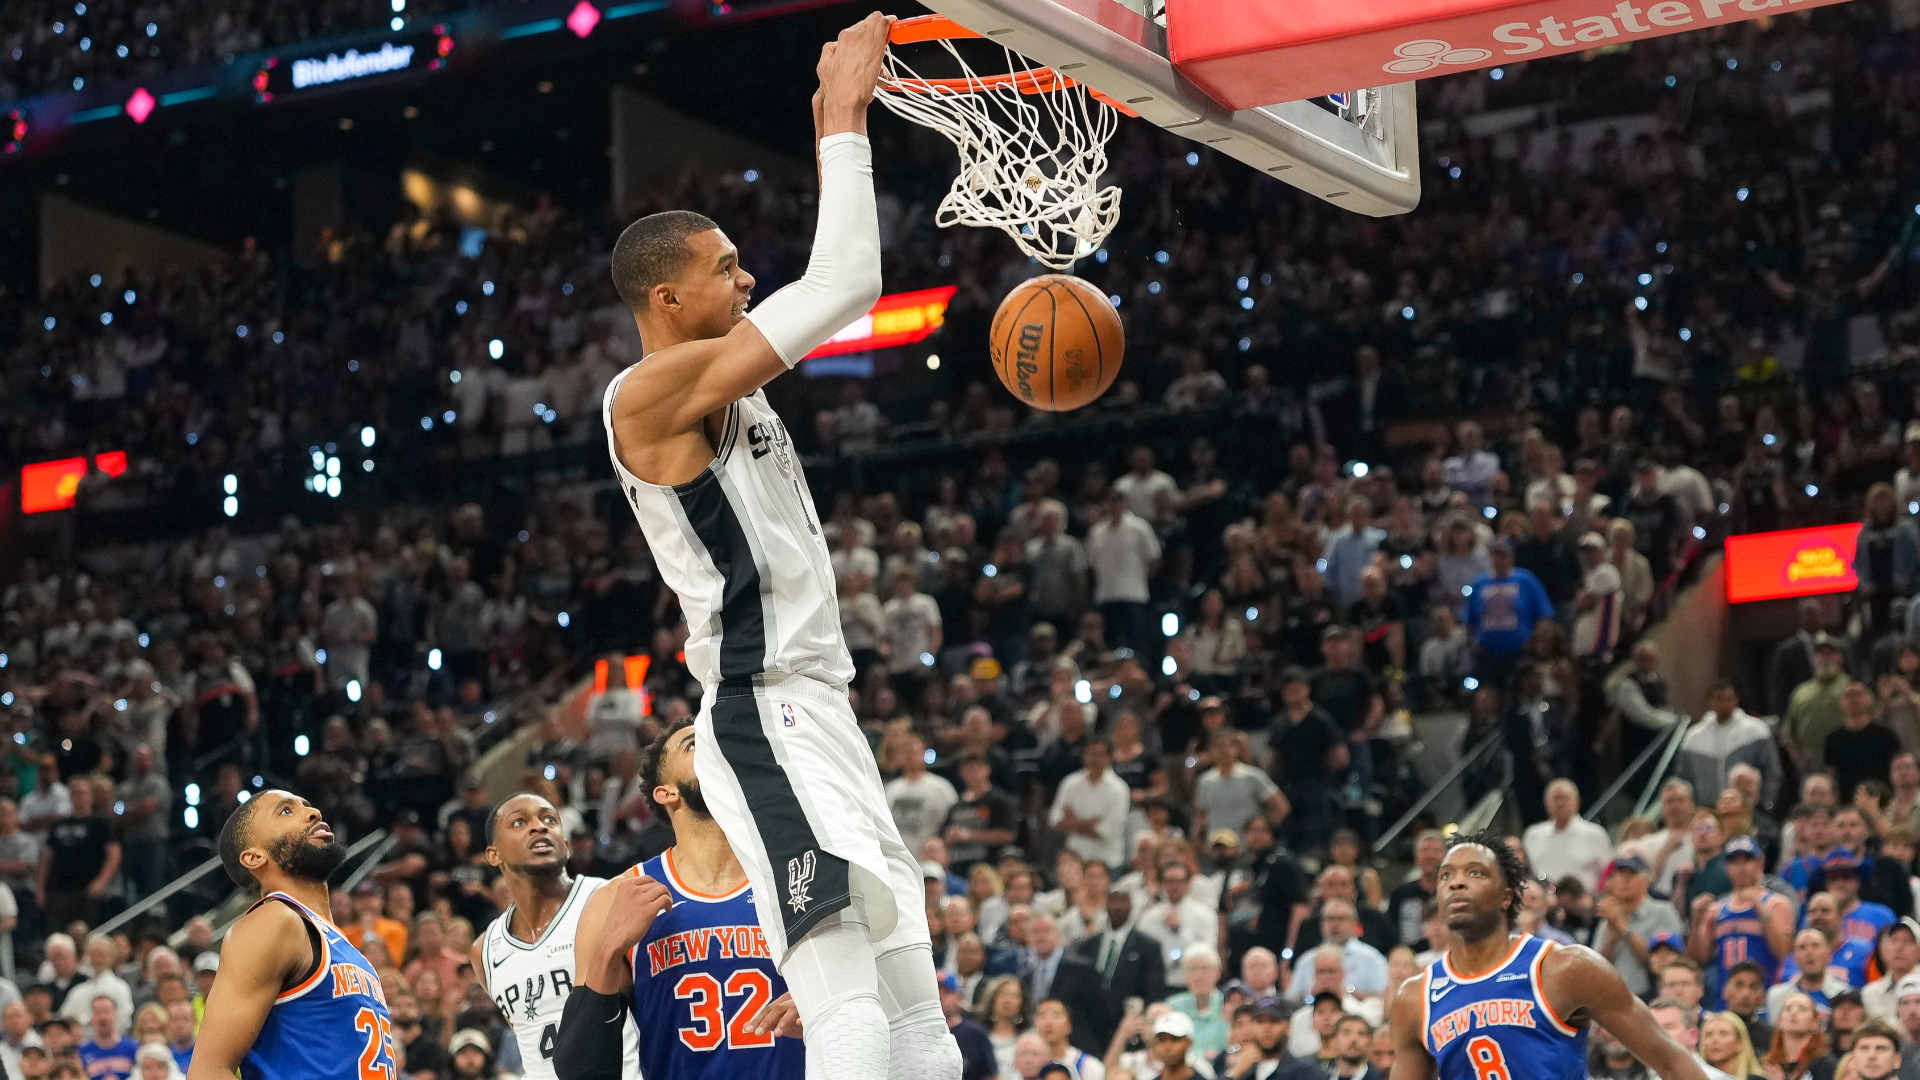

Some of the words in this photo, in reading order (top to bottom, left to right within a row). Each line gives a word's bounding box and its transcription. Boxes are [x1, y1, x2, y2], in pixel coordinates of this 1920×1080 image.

[1492, 0, 1694, 55] State
[292, 42, 415, 89] Bitdefender
[1015, 323, 1044, 402] Wilson
[550, 943, 572, 954] LEDGER
[647, 928, 712, 978] NEW
[713, 924, 773, 960] YOR
[330, 962, 370, 999] NEW
[495, 969, 574, 1021] SPUR
[673, 968, 776, 1053] 32
[1430, 1005, 1472, 1053] NEW
[1472, 998, 1537, 1030] YORK
[354, 1006, 398, 1080] 25
[1465, 1035, 1512, 1080] 8
